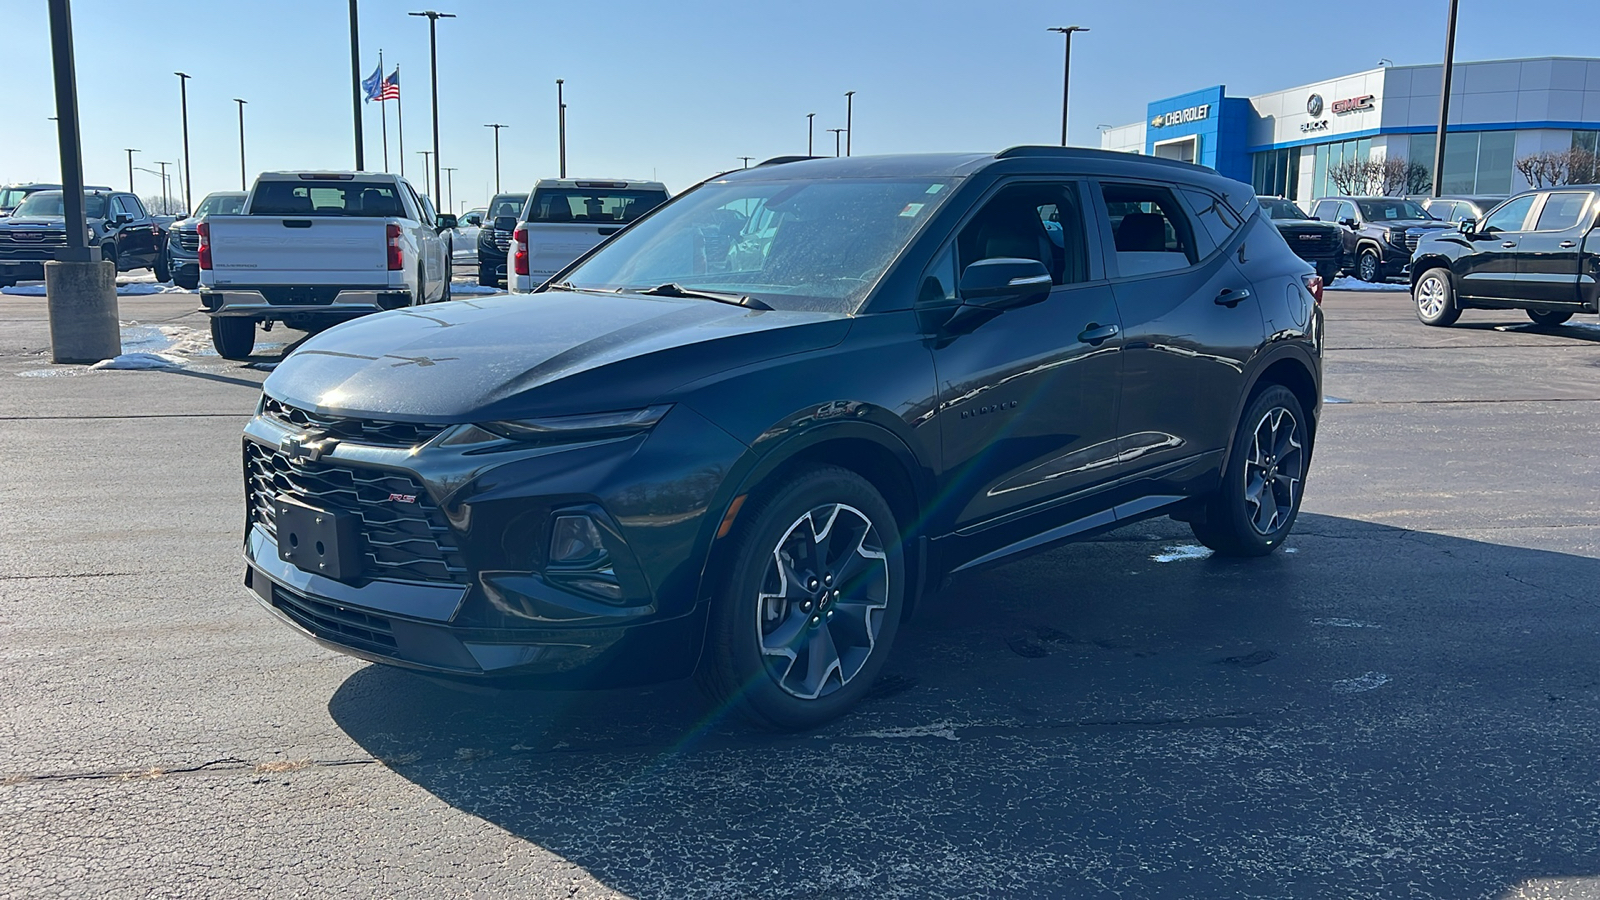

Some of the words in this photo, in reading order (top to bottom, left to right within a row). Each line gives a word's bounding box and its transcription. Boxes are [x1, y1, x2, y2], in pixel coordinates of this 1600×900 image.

[1332, 95, 1373, 114] GMC
[1165, 104, 1209, 126] CHEVROLET
[1301, 120, 1327, 131] BUICK
[960, 400, 1018, 419] BLAZER
[387, 493, 417, 504] RS
